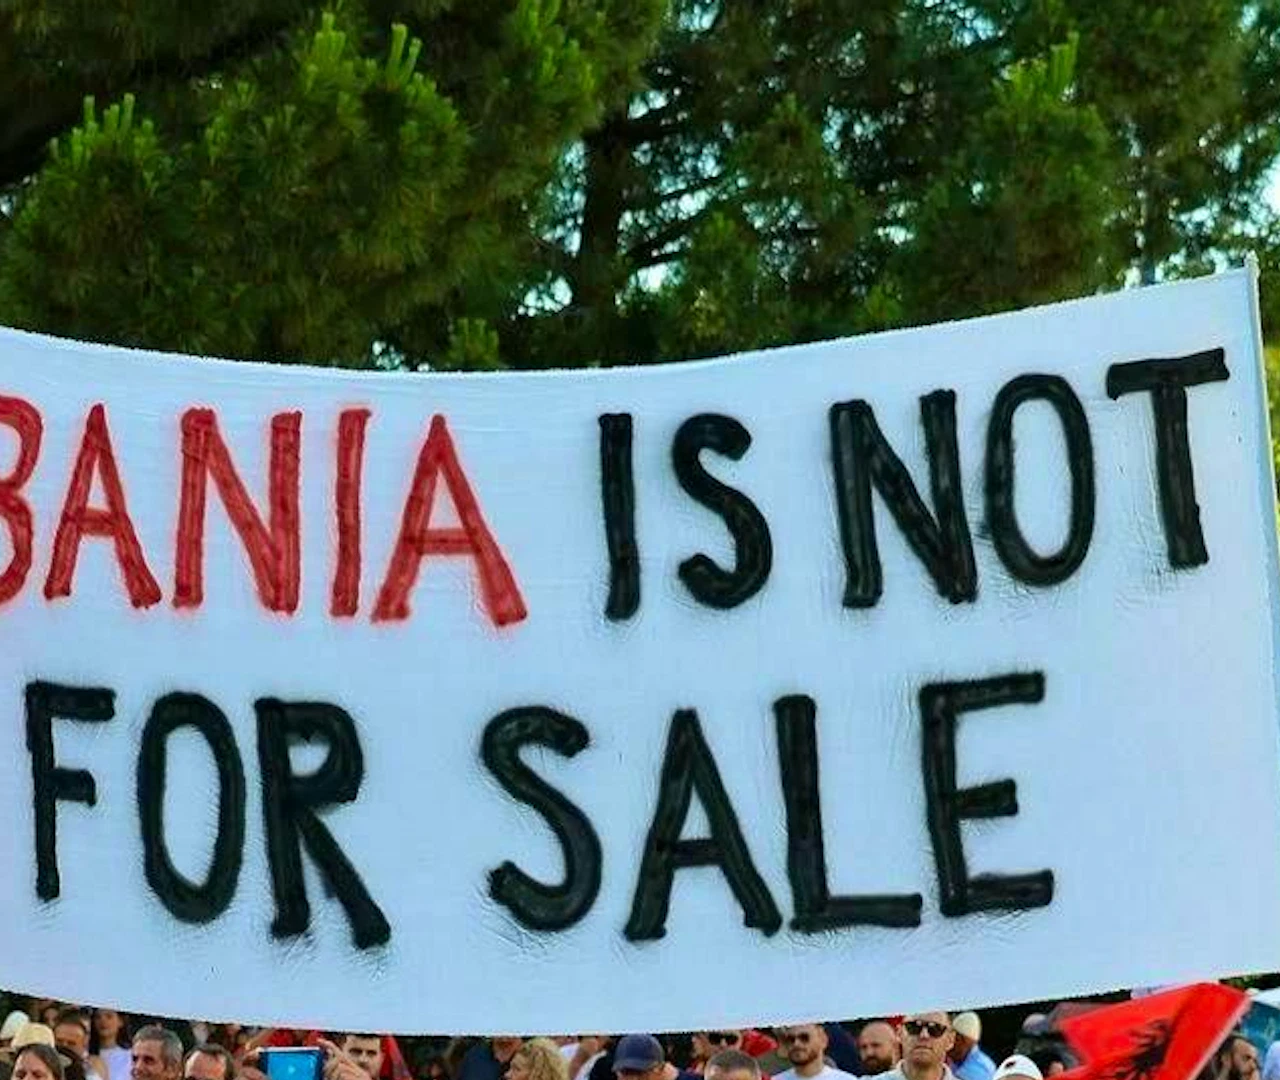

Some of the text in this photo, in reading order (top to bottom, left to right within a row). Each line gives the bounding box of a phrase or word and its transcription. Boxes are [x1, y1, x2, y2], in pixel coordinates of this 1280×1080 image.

[599, 411, 774, 621] IS
[830, 348, 1231, 610] NOT
[24, 671, 1055, 951] FOR SALE
